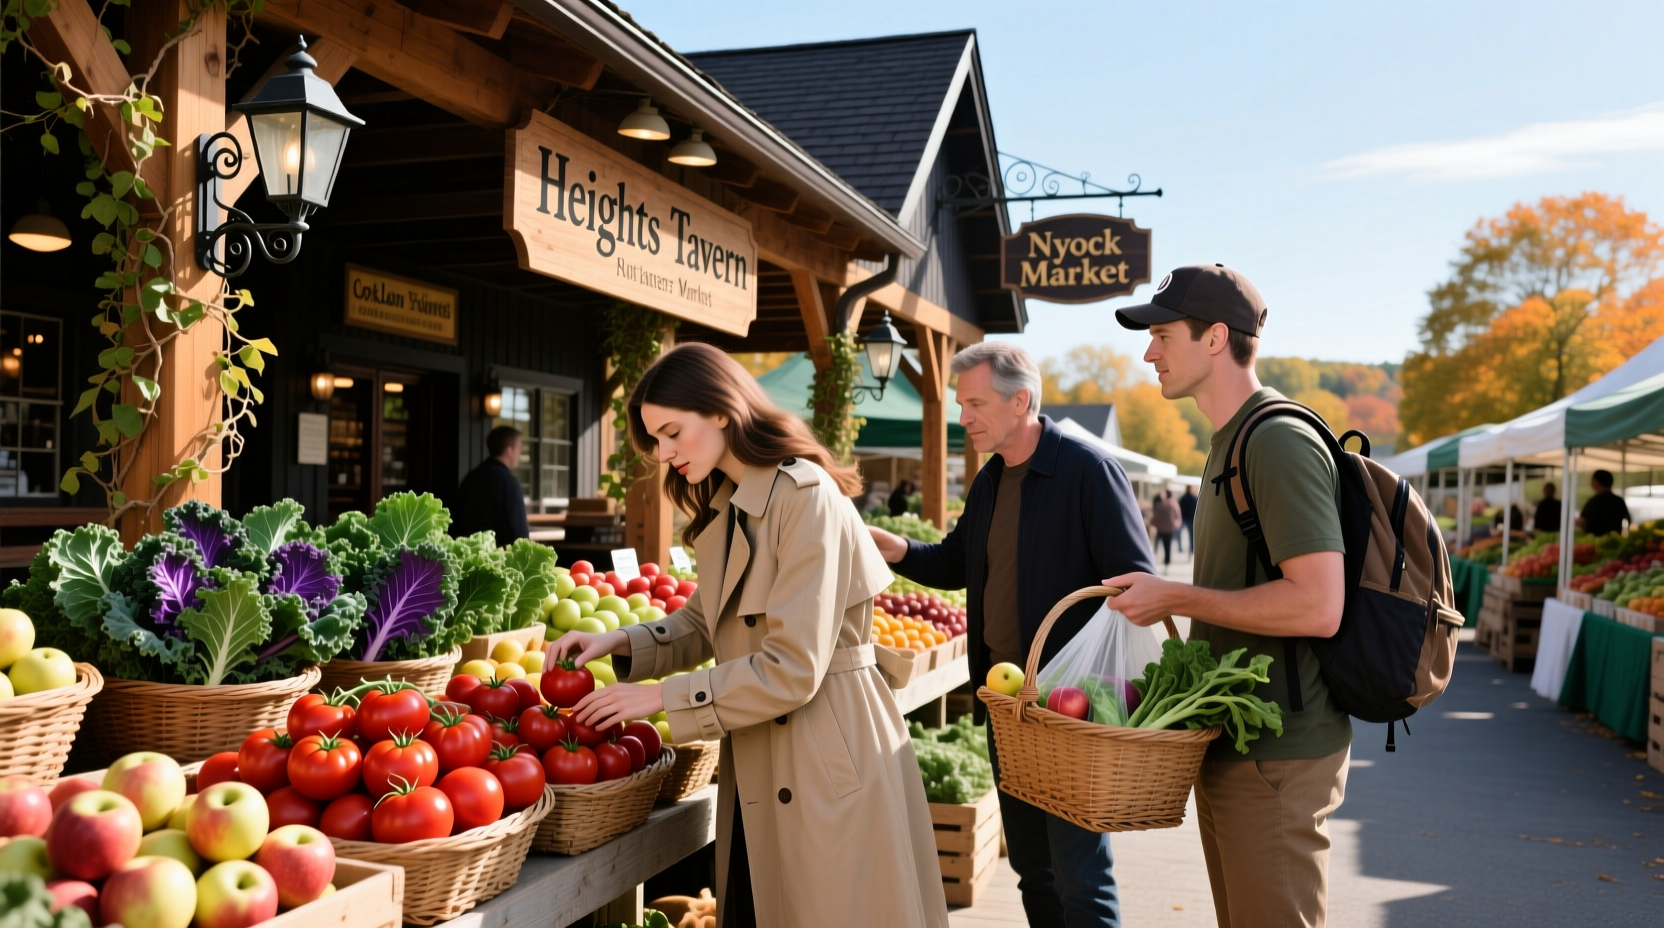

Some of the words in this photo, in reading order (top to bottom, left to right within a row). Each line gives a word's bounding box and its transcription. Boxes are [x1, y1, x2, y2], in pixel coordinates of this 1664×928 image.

[536, 145, 660, 257] Heights
[670, 205, 748, 290] Tavern
[1028, 228, 1123, 265] Nyock
[1020, 257, 1130, 287] Market
